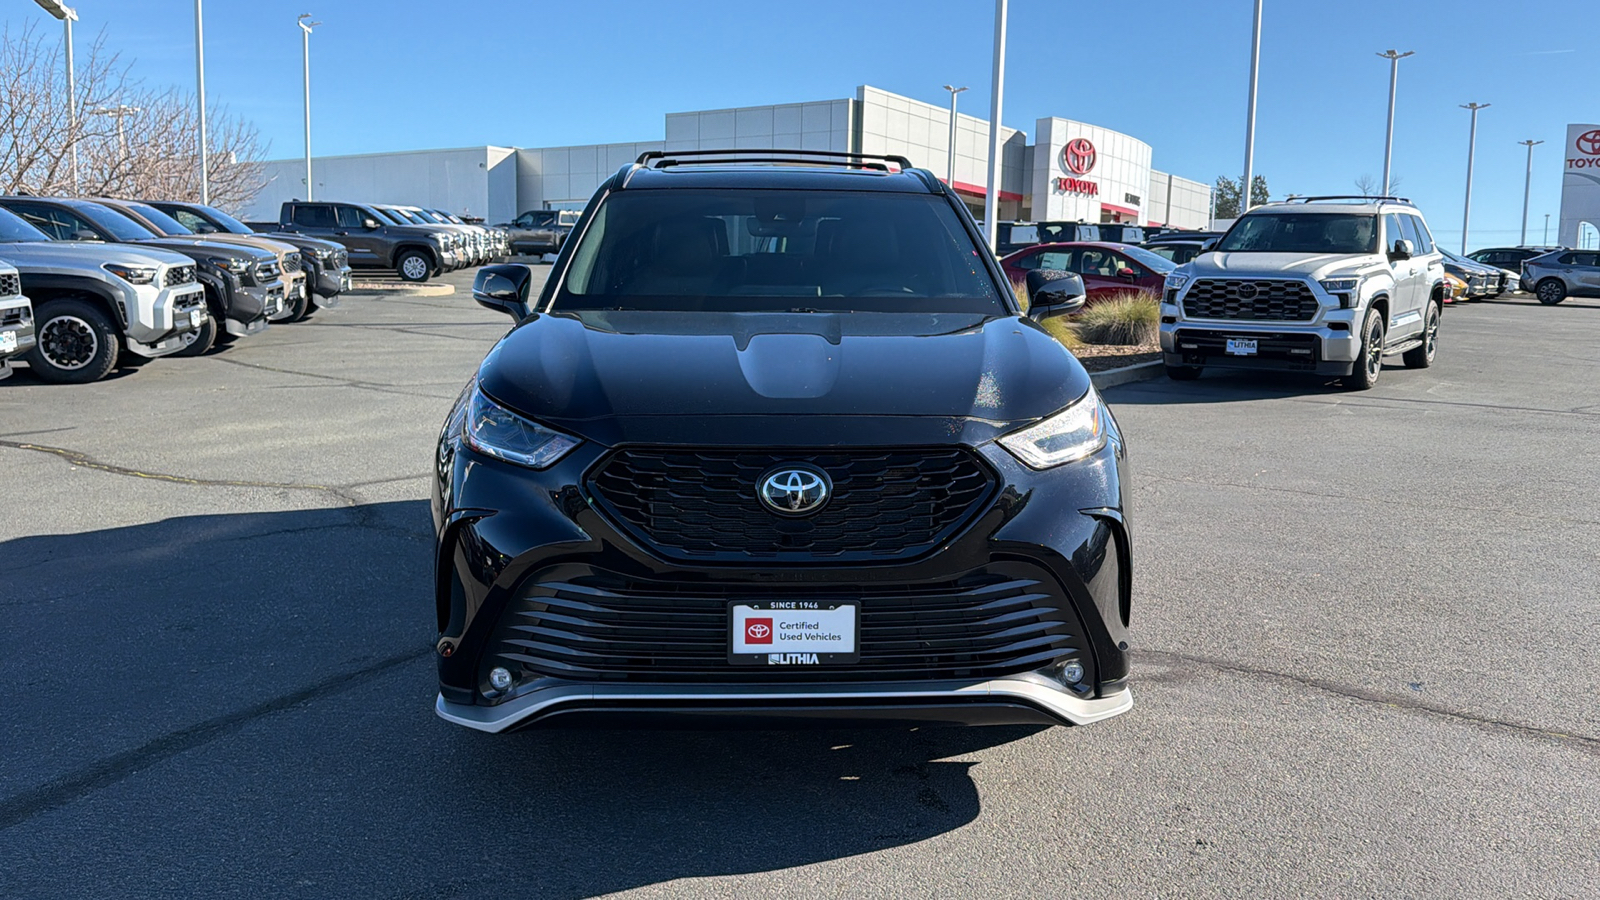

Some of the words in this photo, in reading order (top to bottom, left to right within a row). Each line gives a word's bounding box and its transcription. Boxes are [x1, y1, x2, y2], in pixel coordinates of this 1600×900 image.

[1057, 177, 1098, 195] TOYOTA
[780, 621, 819, 630] Certified
[780, 632, 802, 641] Used
[805, 632, 841, 641] Vehicles
[780, 653, 819, 665] LITHIA
